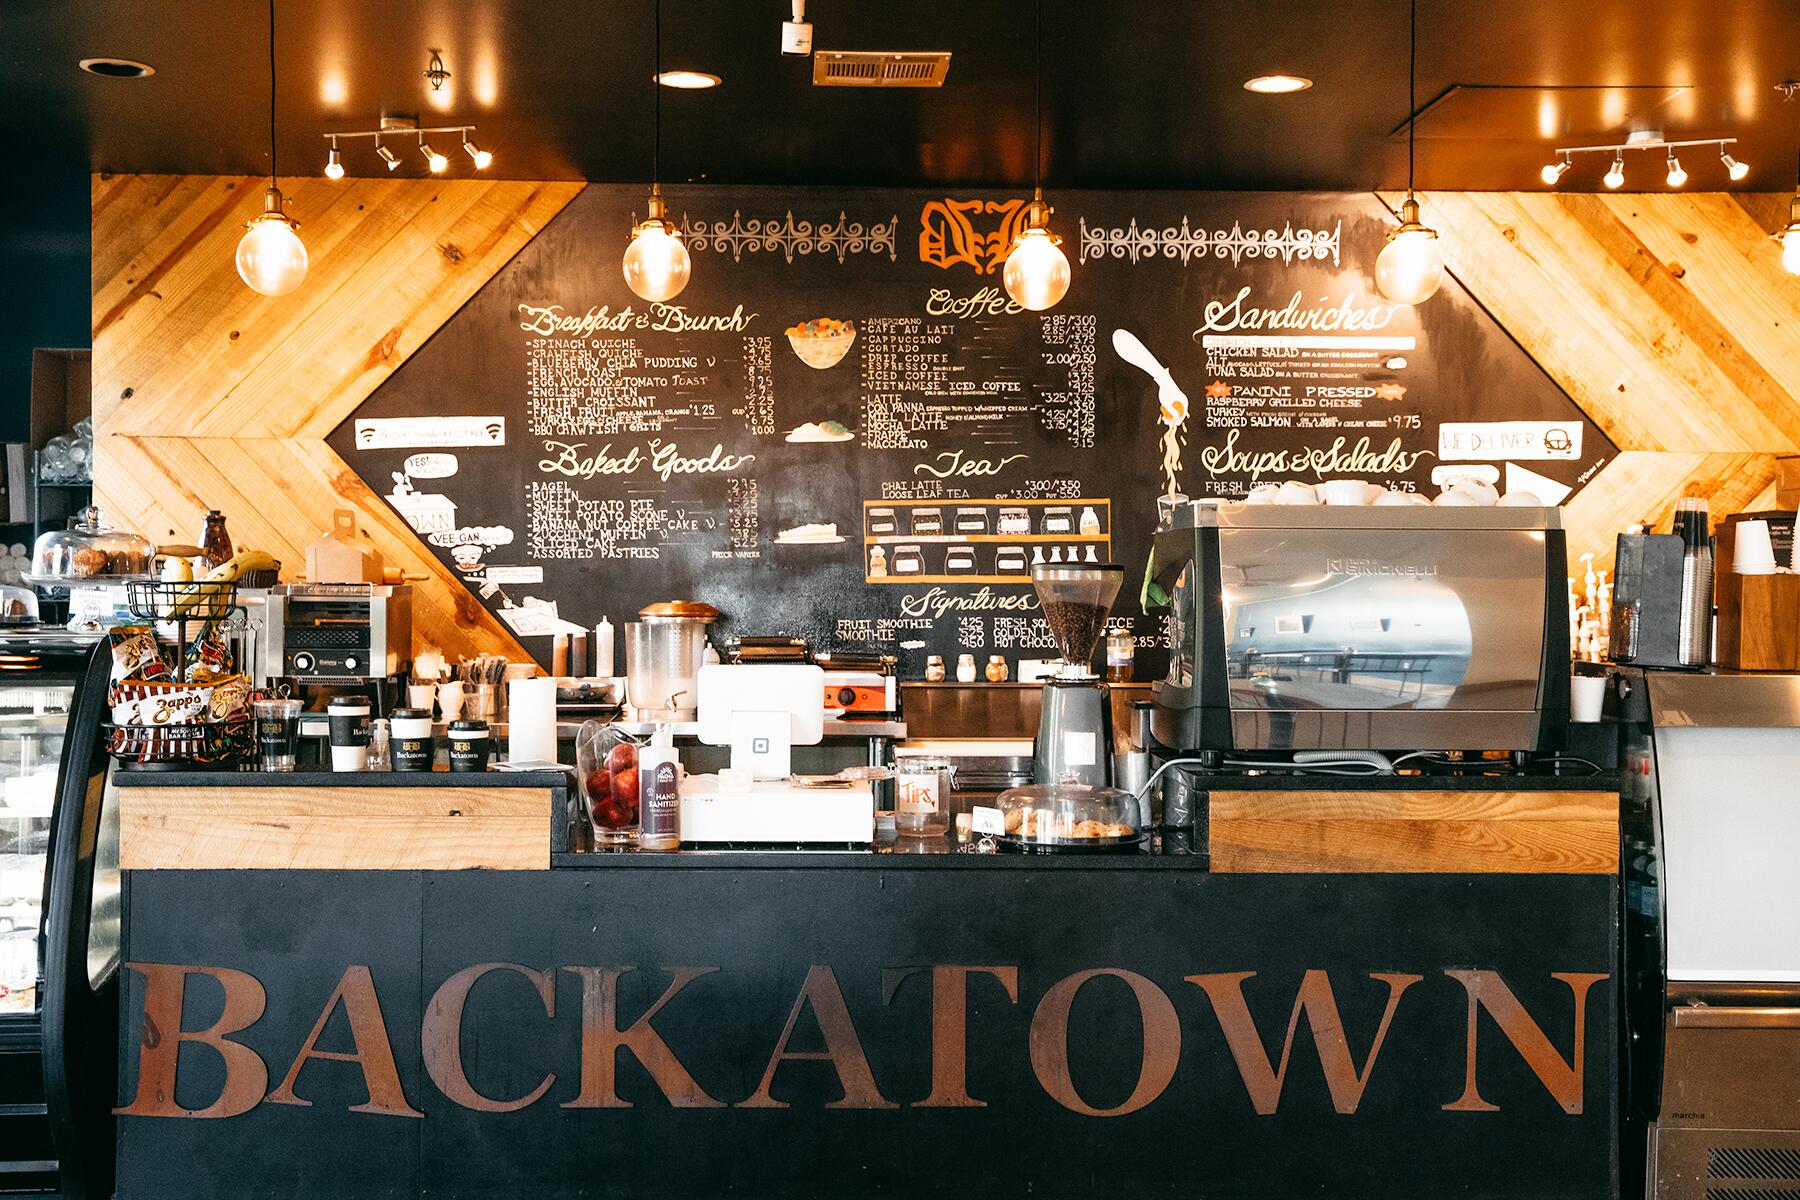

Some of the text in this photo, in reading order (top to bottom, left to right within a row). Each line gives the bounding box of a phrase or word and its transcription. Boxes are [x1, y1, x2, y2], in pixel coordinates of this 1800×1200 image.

[926, 286, 1025, 319] Coffee
[1192, 286, 1413, 342] Sandwiches
[517, 304, 635, 339] Breakfast
[649, 302, 760, 334] Brunch
[904, 325, 918, 334] AU
[926, 325, 956, 335] LAIT
[532, 338, 636, 349] SPINACH QUICHE
[868, 334, 941, 345] CAPPUCCINO
[532, 348, 643, 359] CRAWFISH QUICHE
[868, 344, 919, 353] CORTADO
[1206, 347, 1258, 357] CHICKEN
[1262, 347, 1299, 357] SALAD
[532, 358, 599, 369] BLUEBERRY
[606, 358, 637, 369] CHIA
[644, 356, 697, 368] PUDDING
[868, 353, 949, 364] DRIP COFFEE
[1206, 357, 1227, 368] ALT
[532, 367, 624, 378] FRENCH TOAST
[868, 362, 929, 372] ESPRESSO
[1206, 367, 1236, 377] TUNA
[1240, 367, 1275, 377] SALAD
[868, 371, 949, 381] ICED COFFEE
[623, 377, 667, 387] TOMATO
[867, 380, 1021, 391] VIETNAMESE ICED COFFEE
[532, 386, 637, 398] ENGLISH MUFFIN
[1233, 385, 1377, 398] PANINI PRESSED
[532, 396, 656, 408] BUTTER CROISSANT
[867, 394, 902, 404] LATTE
[1206, 397, 1362, 408] RASPBERRY GRILLED CHEESE
[532, 407, 574, 418] FRESH
[577, 407, 615, 418] FRUIT
[867, 403, 888, 413] CON
[892, 402, 926, 413] PANNA
[1206, 407, 1245, 417] TURKEY
[604, 415, 643, 425] CHEESE
[868, 412, 899, 422] MIEL
[904, 411, 942, 422] LATTE
[1206, 417, 1249, 427] SMOKED
[1250, 416, 1292, 427] SALMON
[534, 420, 661, 437] BBQ CRAWFISH GRITS
[868, 419, 948, 431] MOCHA LATTE
[868, 439, 928, 450] MACCHIATO
[1471, 431, 1535, 451] DELIVER
[538, 438, 755, 482] Baked Goods
[1200, 428, 1290, 482] Soups
[1309, 436, 1436, 481] Salads
[913, 449, 1029, 479] Tea
[532, 481, 571, 492] BAGEL
[881, 480, 942, 491] CHAI LATTE
[1205, 481, 1243, 492] FRESH
[532, 491, 578, 501] MUFFIN
[882, 489, 914, 499] LOOSE
[918, 488, 943, 499] LEAF
[947, 488, 970, 499] TEA
[532, 500, 653, 512] SWEET POTATO PIE
[532, 509, 668, 521] SWEET POTATO SCONE
[532, 519, 579, 530] BANANA
[584, 519, 610, 530] NUT
[616, 519, 660, 530] COFFEE
[668, 519, 698, 530] CAKE
[532, 529, 593, 541] ZUCCHINI
[600, 529, 646, 540] MUFFIN
[532, 539, 616, 549] SLICED CAKE
[532, 548, 593, 559] ASSORTED
[601, 547, 659, 559] PASTRIES
[900, 586, 1042, 618] Signatures
[838, 617, 1027, 630] FRUIT SMOOTHIE FRESH
[836, 627, 1036, 641] SMOOTHIE GOLDEN
[995, 637, 1015, 648] HOT
[396, 751, 428, 759] Backatown
[111, 961, 1611, 1119] BACKATOWN
